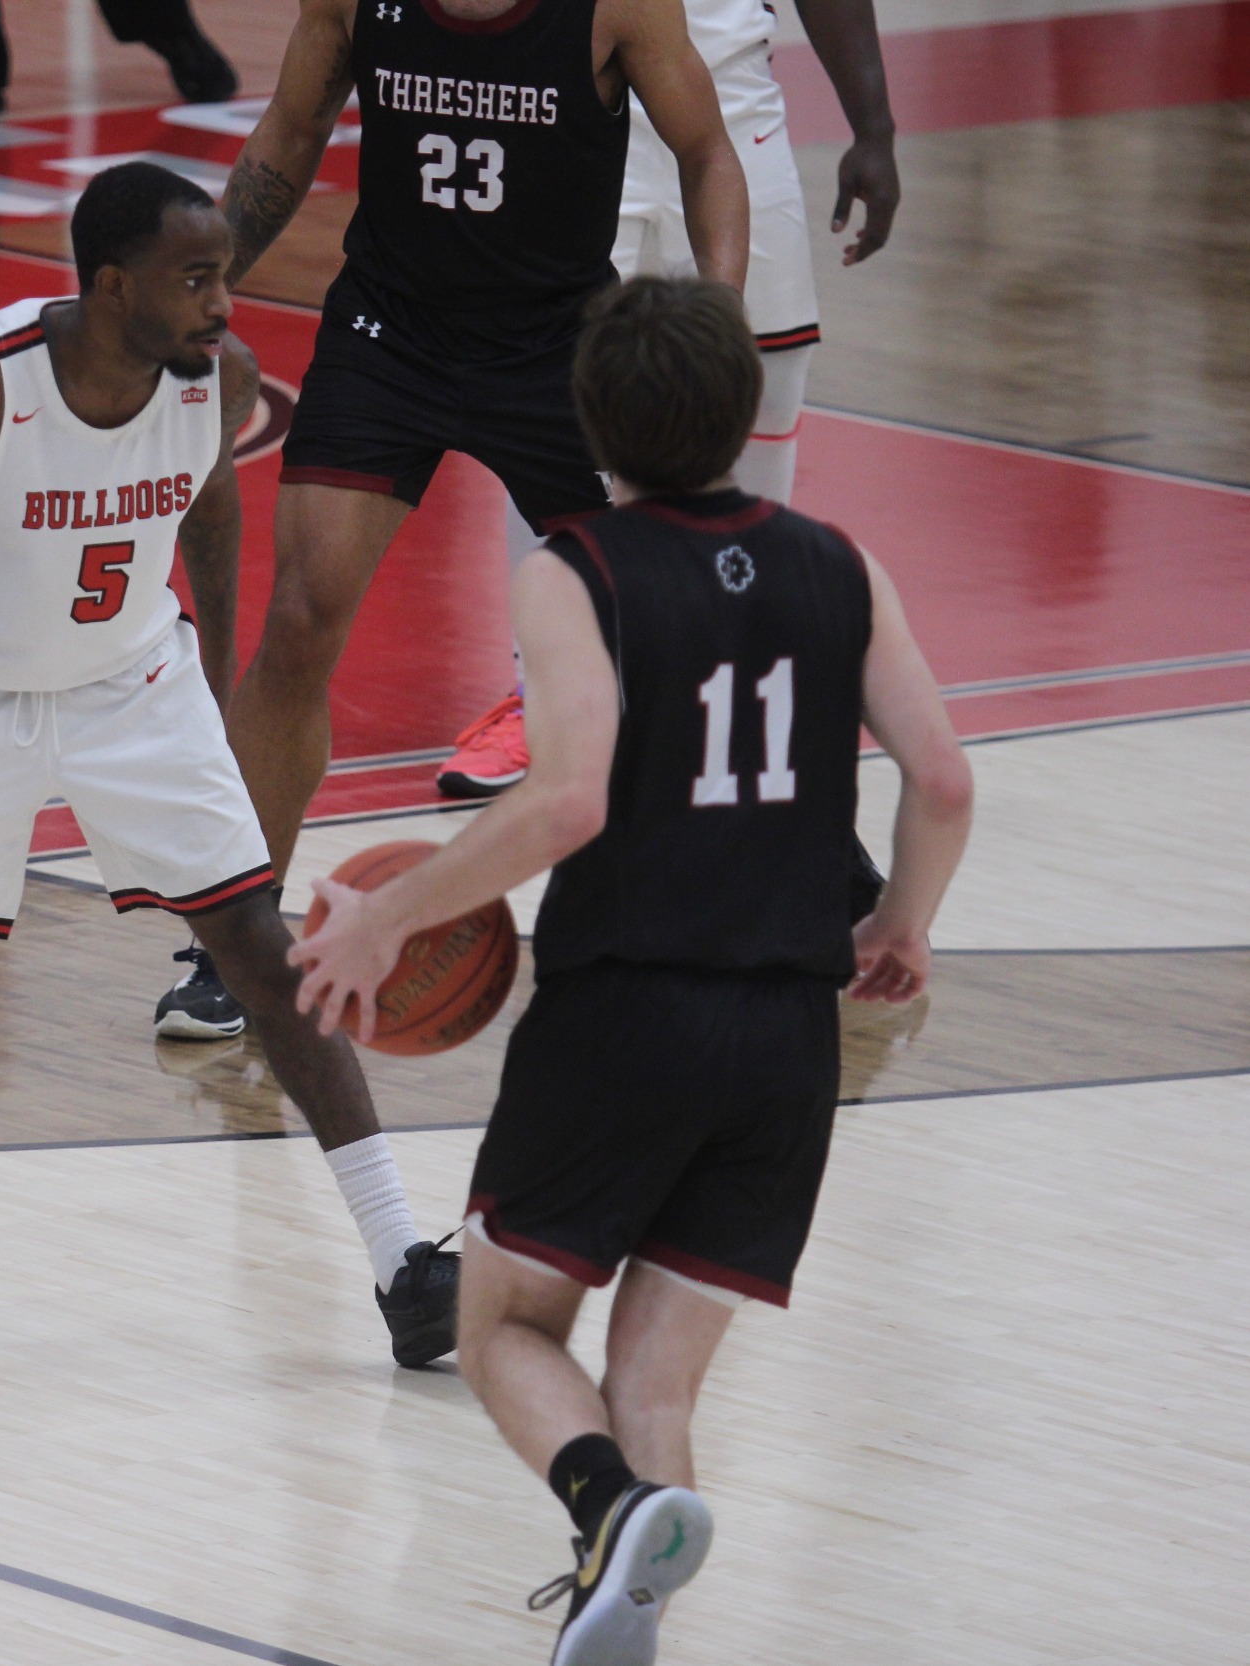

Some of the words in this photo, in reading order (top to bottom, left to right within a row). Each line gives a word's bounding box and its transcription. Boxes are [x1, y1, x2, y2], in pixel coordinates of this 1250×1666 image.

[375, 68, 558, 125] THRESHERS
[418, 133, 504, 212] 23
[22, 472, 193, 530] BULLDOGS
[70, 540, 135, 624] 5
[691, 657, 796, 807] 11
